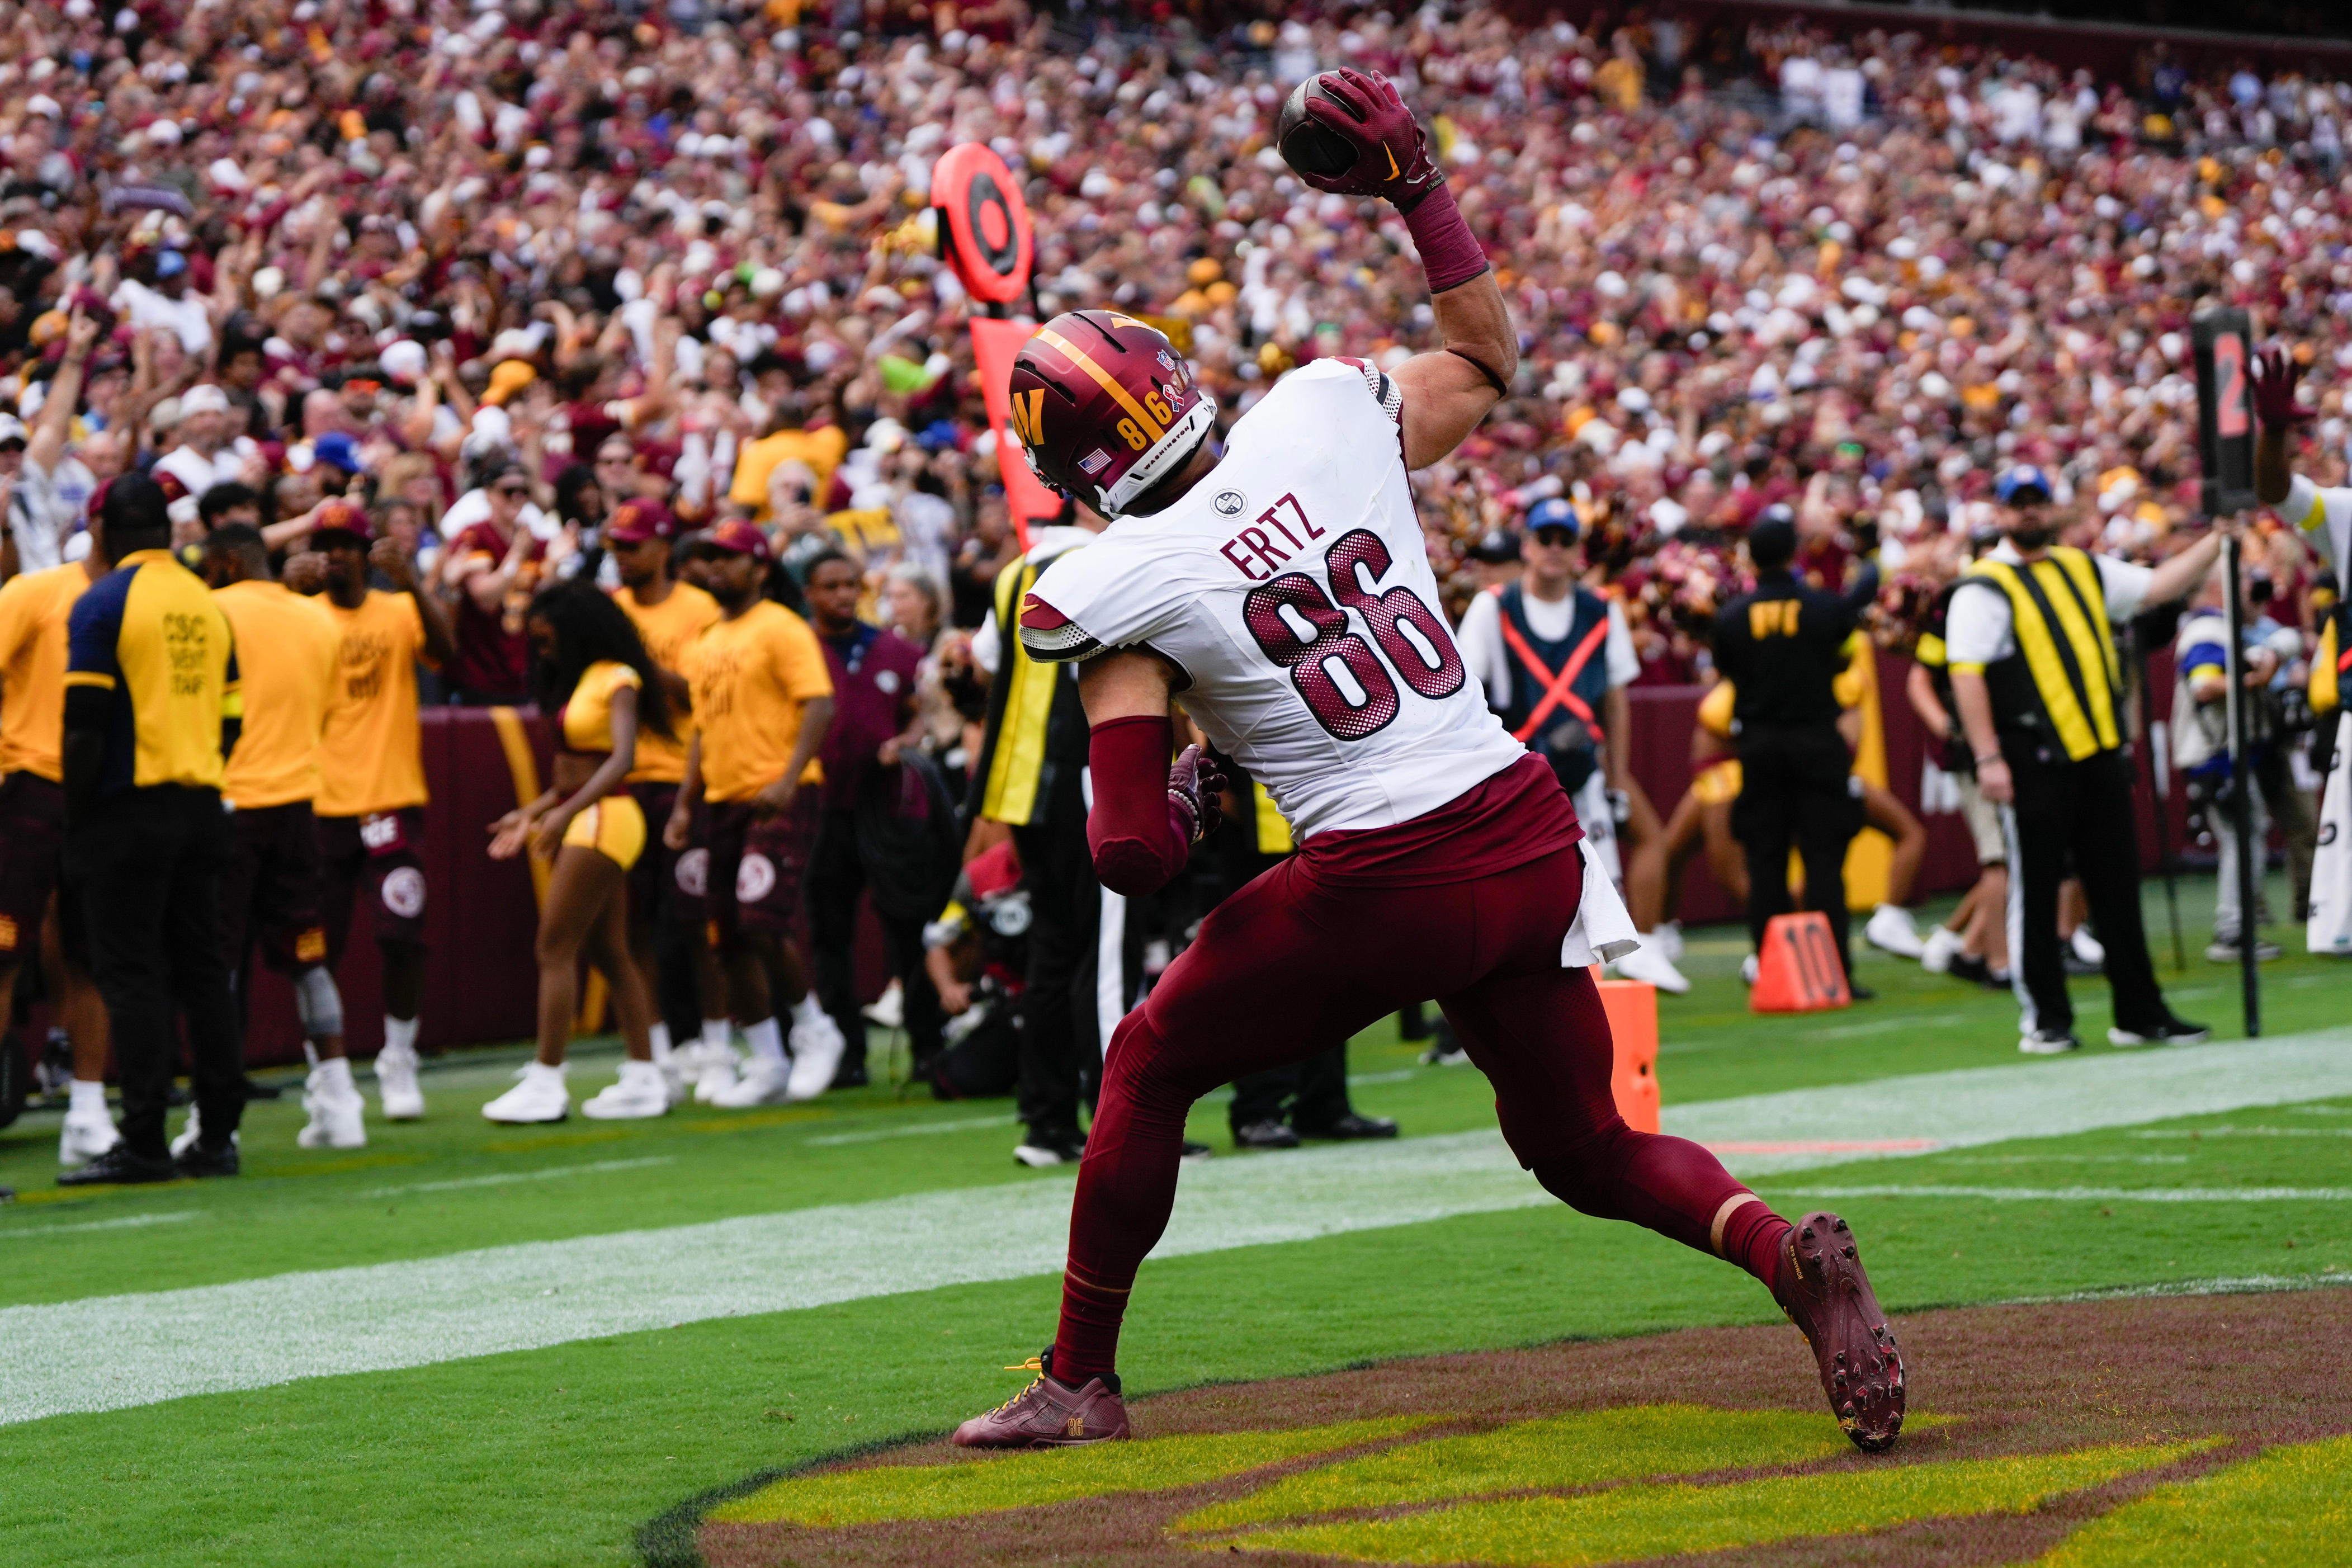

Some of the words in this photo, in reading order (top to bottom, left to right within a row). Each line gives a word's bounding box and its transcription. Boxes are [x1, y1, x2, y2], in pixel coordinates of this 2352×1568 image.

[1430, 179, 1442, 188] John
[2214, 333, 2248, 437] 2
[1144, 426, 1189, 470] WASHINGTON
[1220, 492, 1326, 580] ERTZ
[1243, 528, 1466, 742] 86
[1786, 923, 1843, 1002] 10
[1792, 1257, 1803, 1280] ROMANS
[1068, 1418, 1084, 1437] 86
